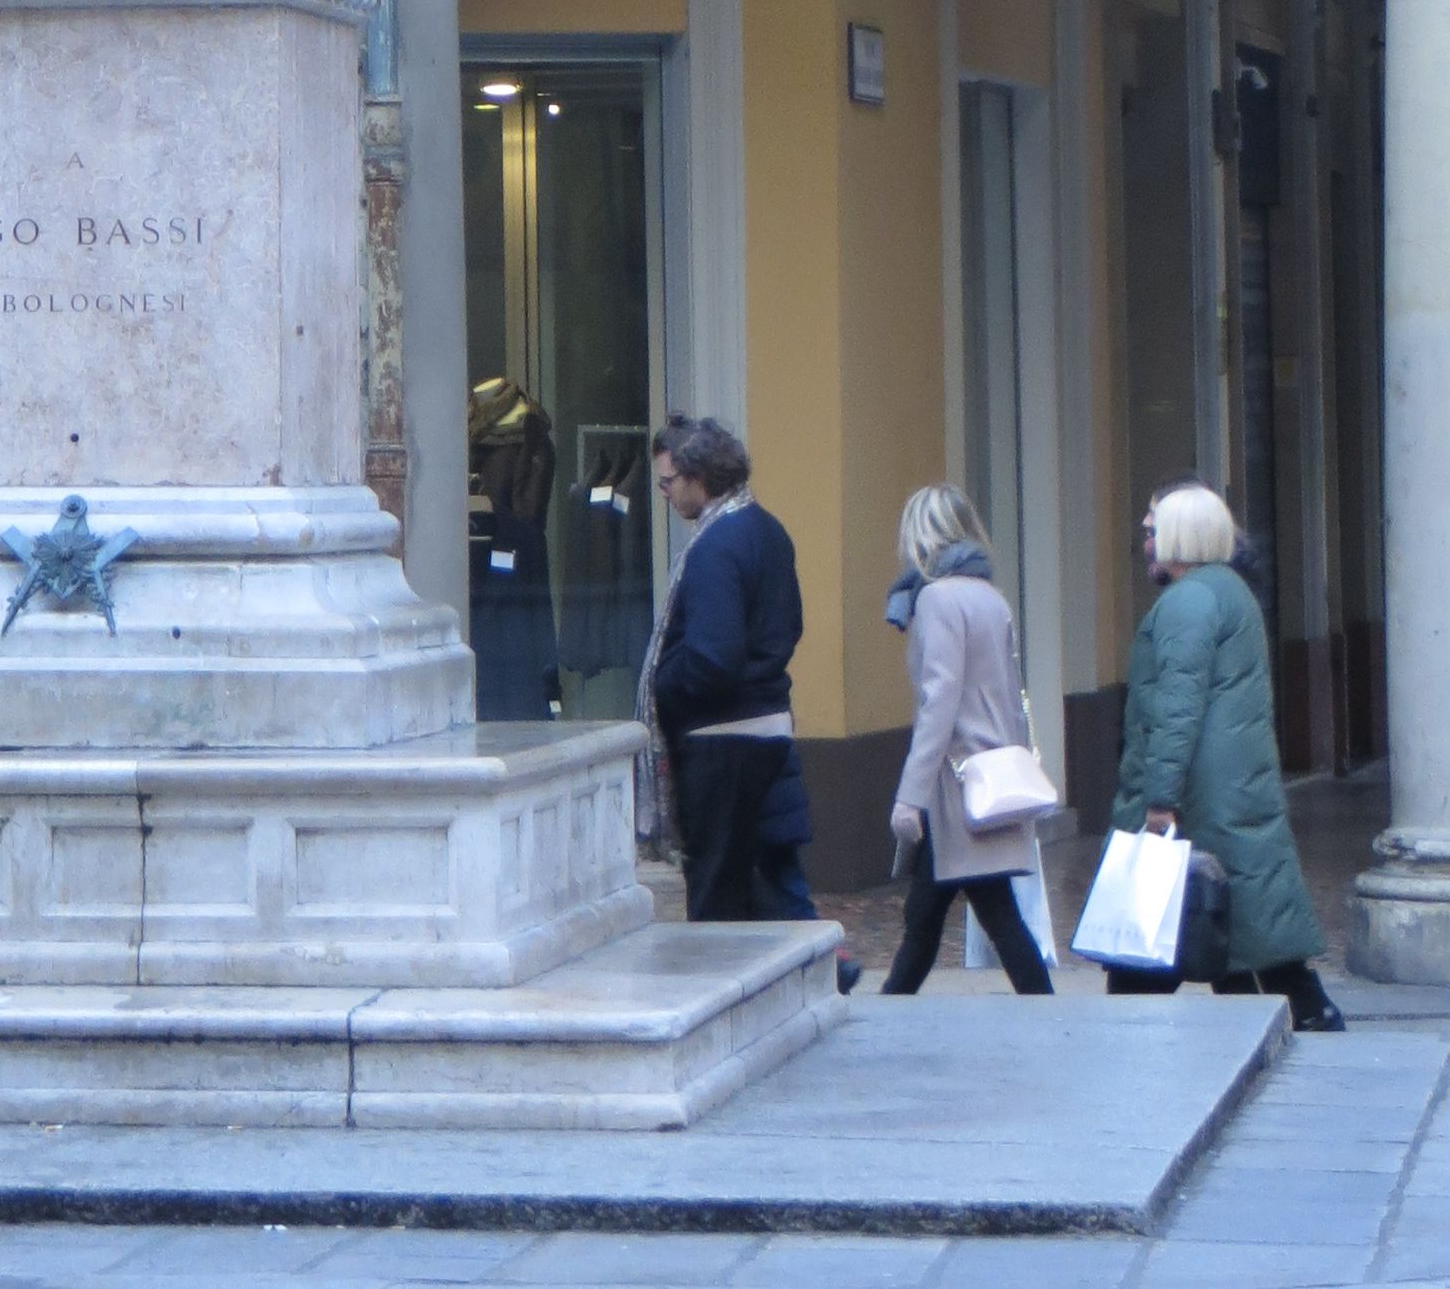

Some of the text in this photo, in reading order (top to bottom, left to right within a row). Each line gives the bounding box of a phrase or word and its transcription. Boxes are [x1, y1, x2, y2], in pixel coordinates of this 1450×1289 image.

[67, 152, 84, 169] A
[77, 217, 203, 246] BASSI
[3, 293, 186, 314] BOLOGNESI
